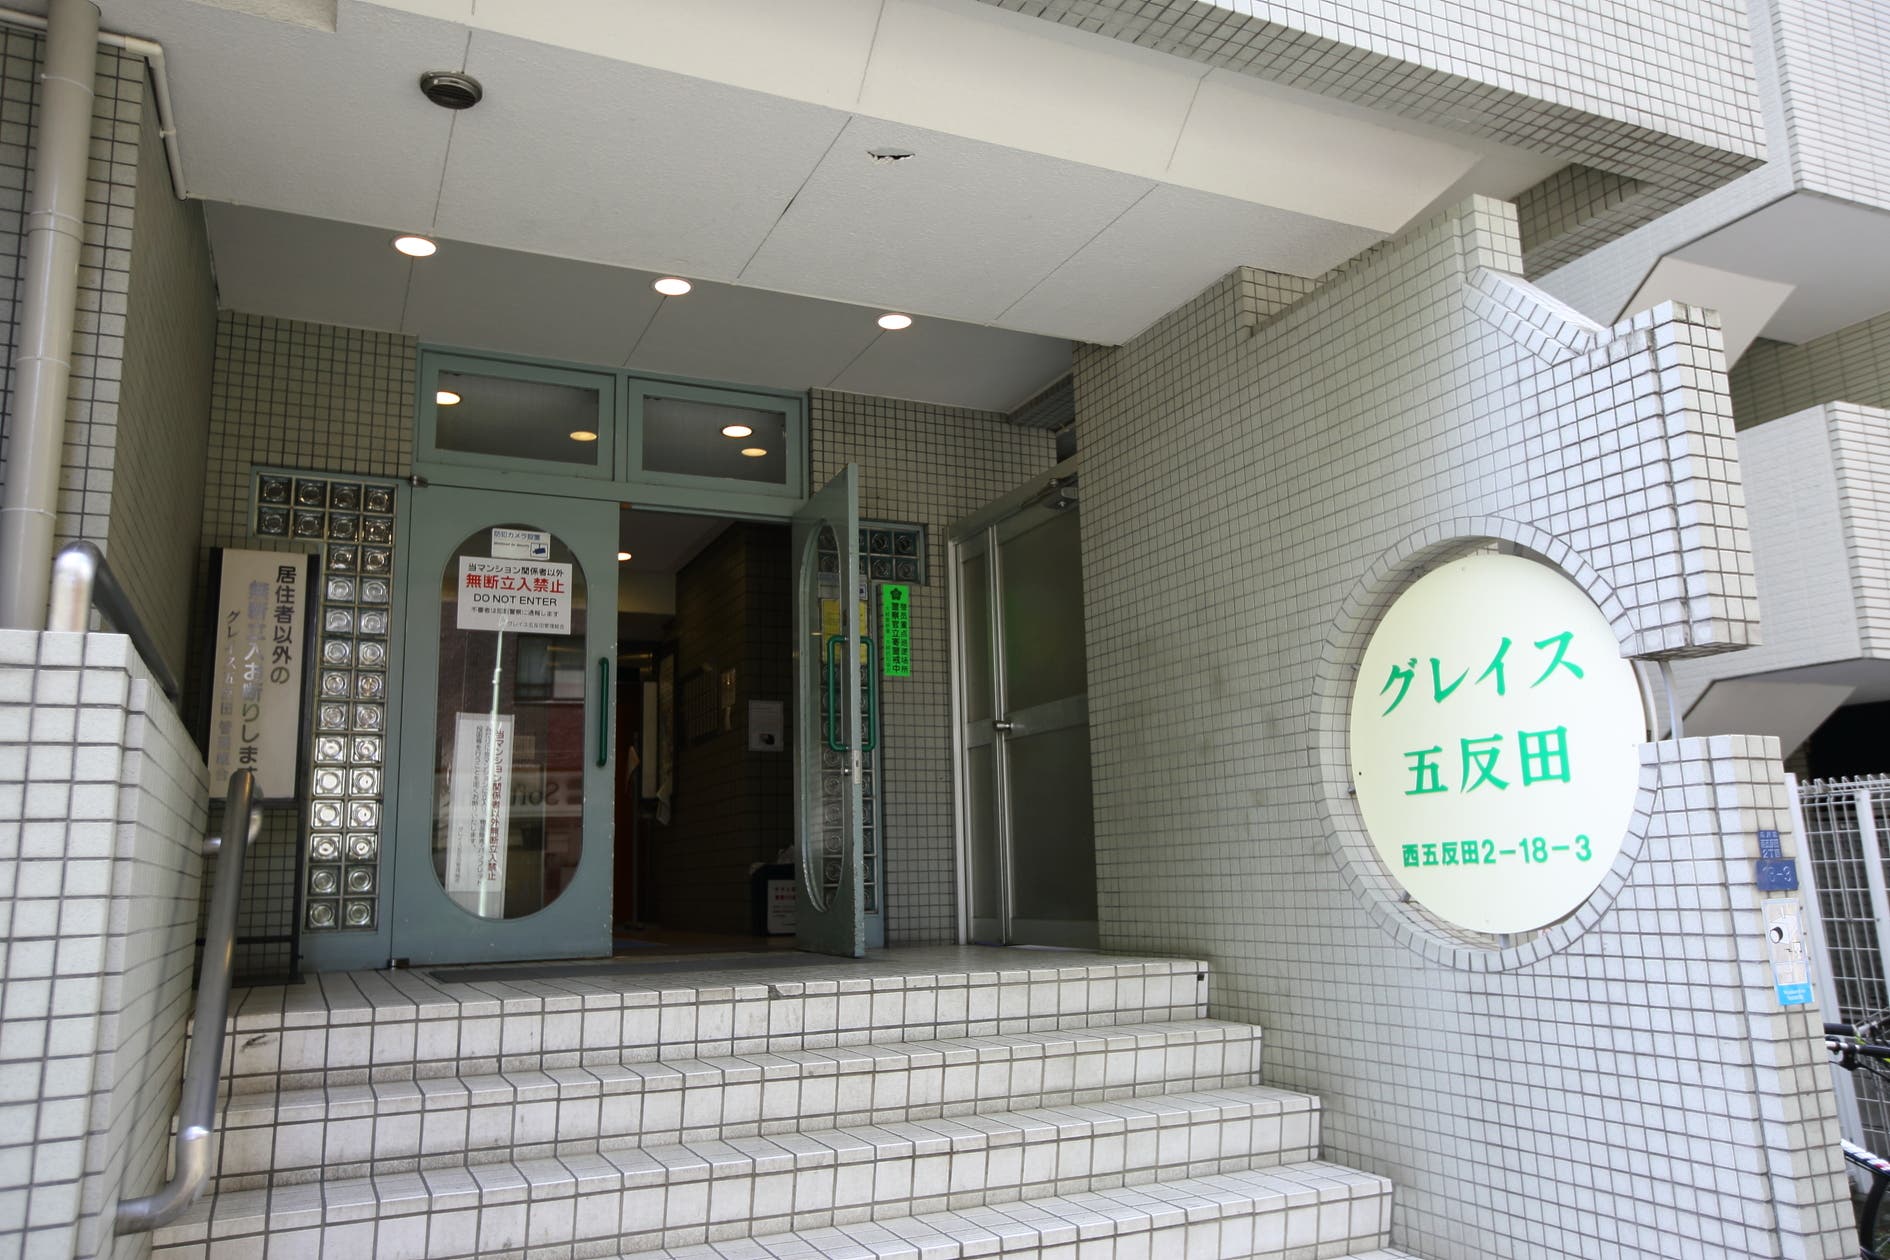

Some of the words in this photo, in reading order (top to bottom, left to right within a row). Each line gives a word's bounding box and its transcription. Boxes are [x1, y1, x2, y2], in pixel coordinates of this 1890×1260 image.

[466, 573, 565, 594] 無断立入禁止
[468, 562, 564, 577] 当マンション関係者以外
[473, 593, 490, 603] DO
[493, 595, 516, 604] NOT
[519, 596, 557, 607] ENTER
[270, 565, 297, 685] 居住者以外の
[238, 580, 270, 775] 無断立入お断りしま
[1379, 631, 1585, 718] グレイス
[1403, 725, 1571, 796] 五反田
[487, 730, 505, 880] 当マンション関係者以外無断立入禁止
